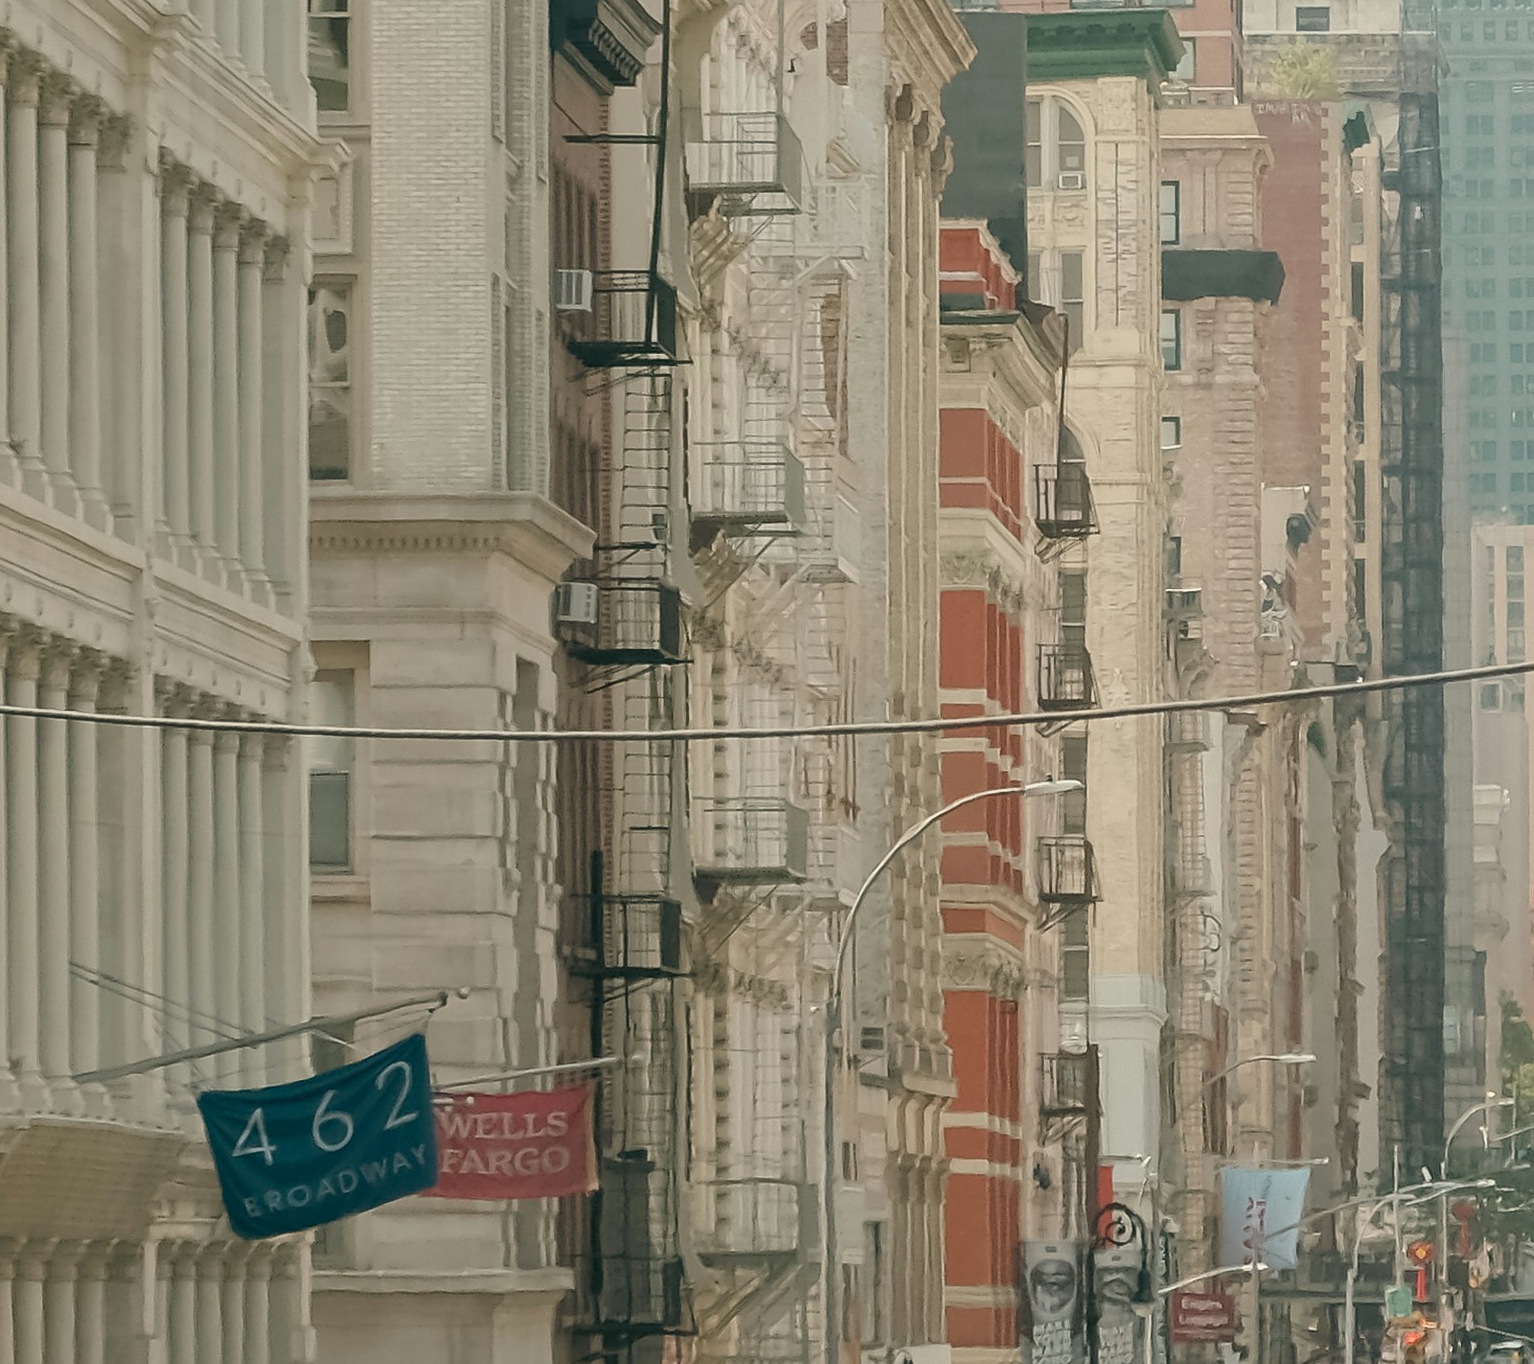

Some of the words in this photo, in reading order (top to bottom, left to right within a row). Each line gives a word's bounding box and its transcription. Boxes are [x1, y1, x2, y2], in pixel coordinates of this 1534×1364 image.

[232, 1060, 419, 1166] 462
[434, 1108, 568, 1141] WELLS
[245, 1143, 429, 1217] BROADWAY
[439, 1146, 569, 1177] FARGO
